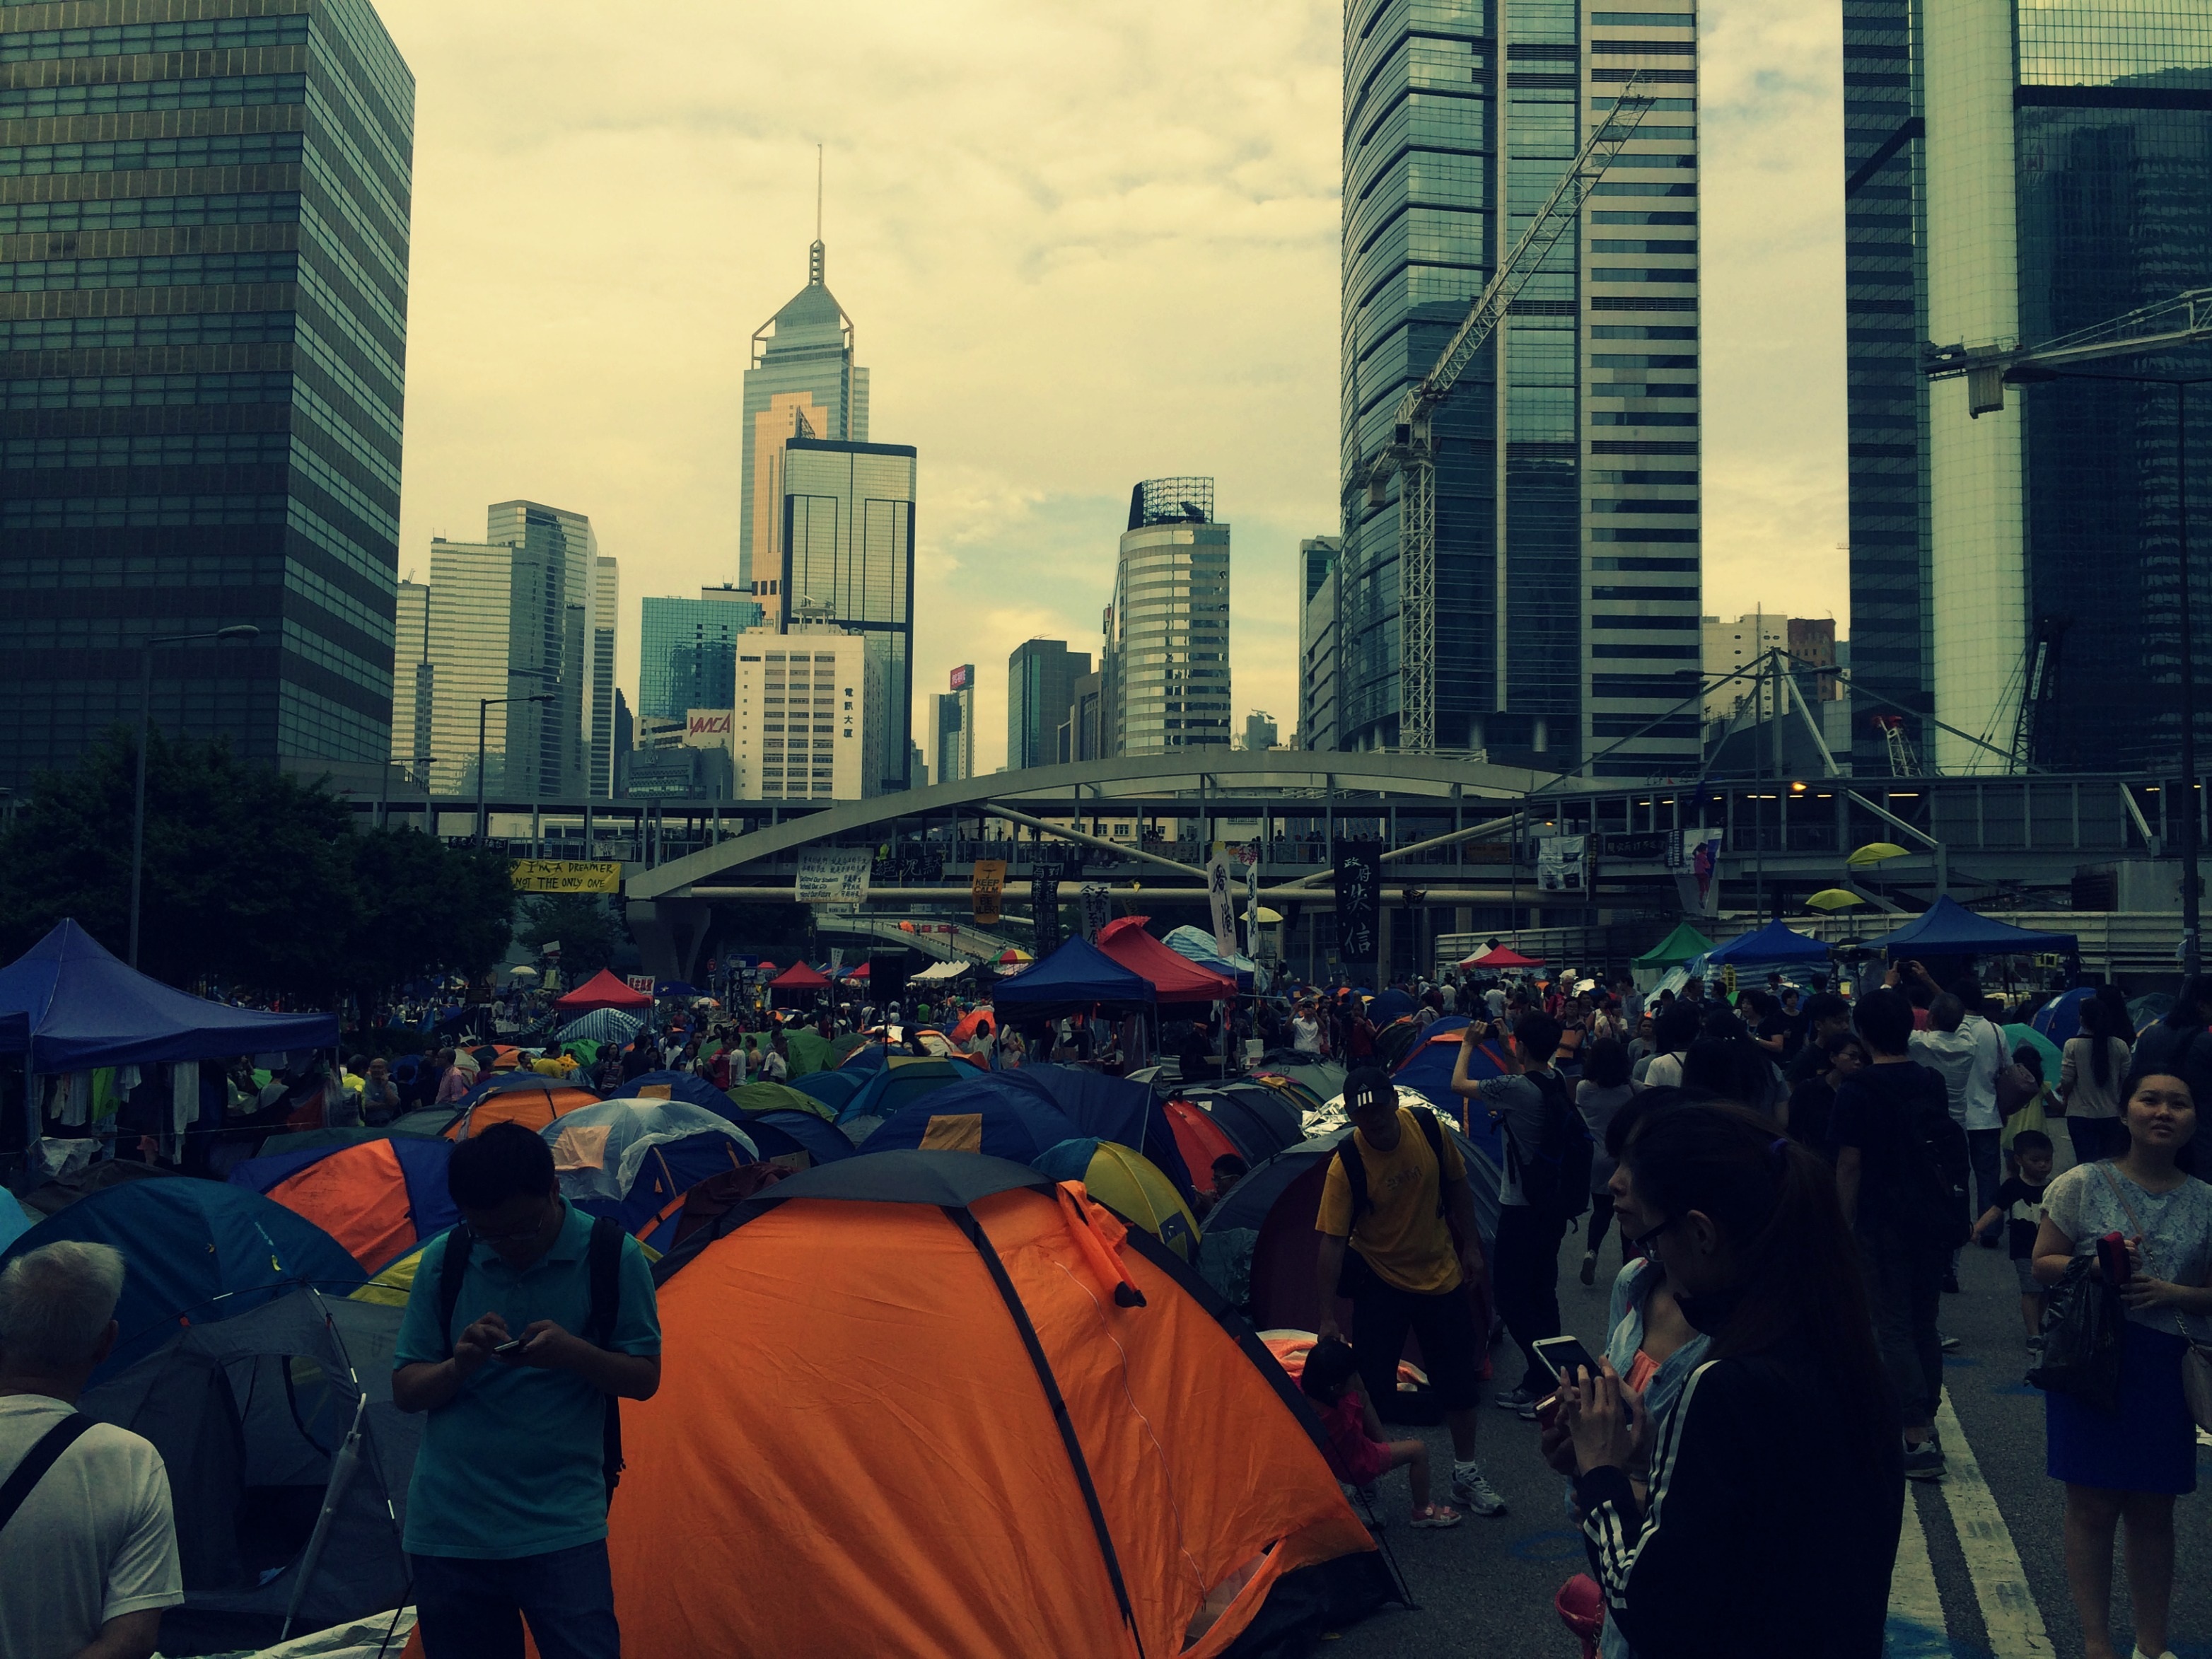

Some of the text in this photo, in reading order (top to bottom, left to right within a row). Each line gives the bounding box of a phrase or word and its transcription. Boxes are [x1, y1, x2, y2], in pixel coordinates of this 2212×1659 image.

[689, 712, 730, 737] YMCA
[554, 863, 563, 873] A
[569, 862, 614, 873] DREAMER
[516, 877, 605, 890] NOT THE ONLY ONE
[980, 897, 992, 905] BE
[1344, 857, 1373, 955] 政府失信
